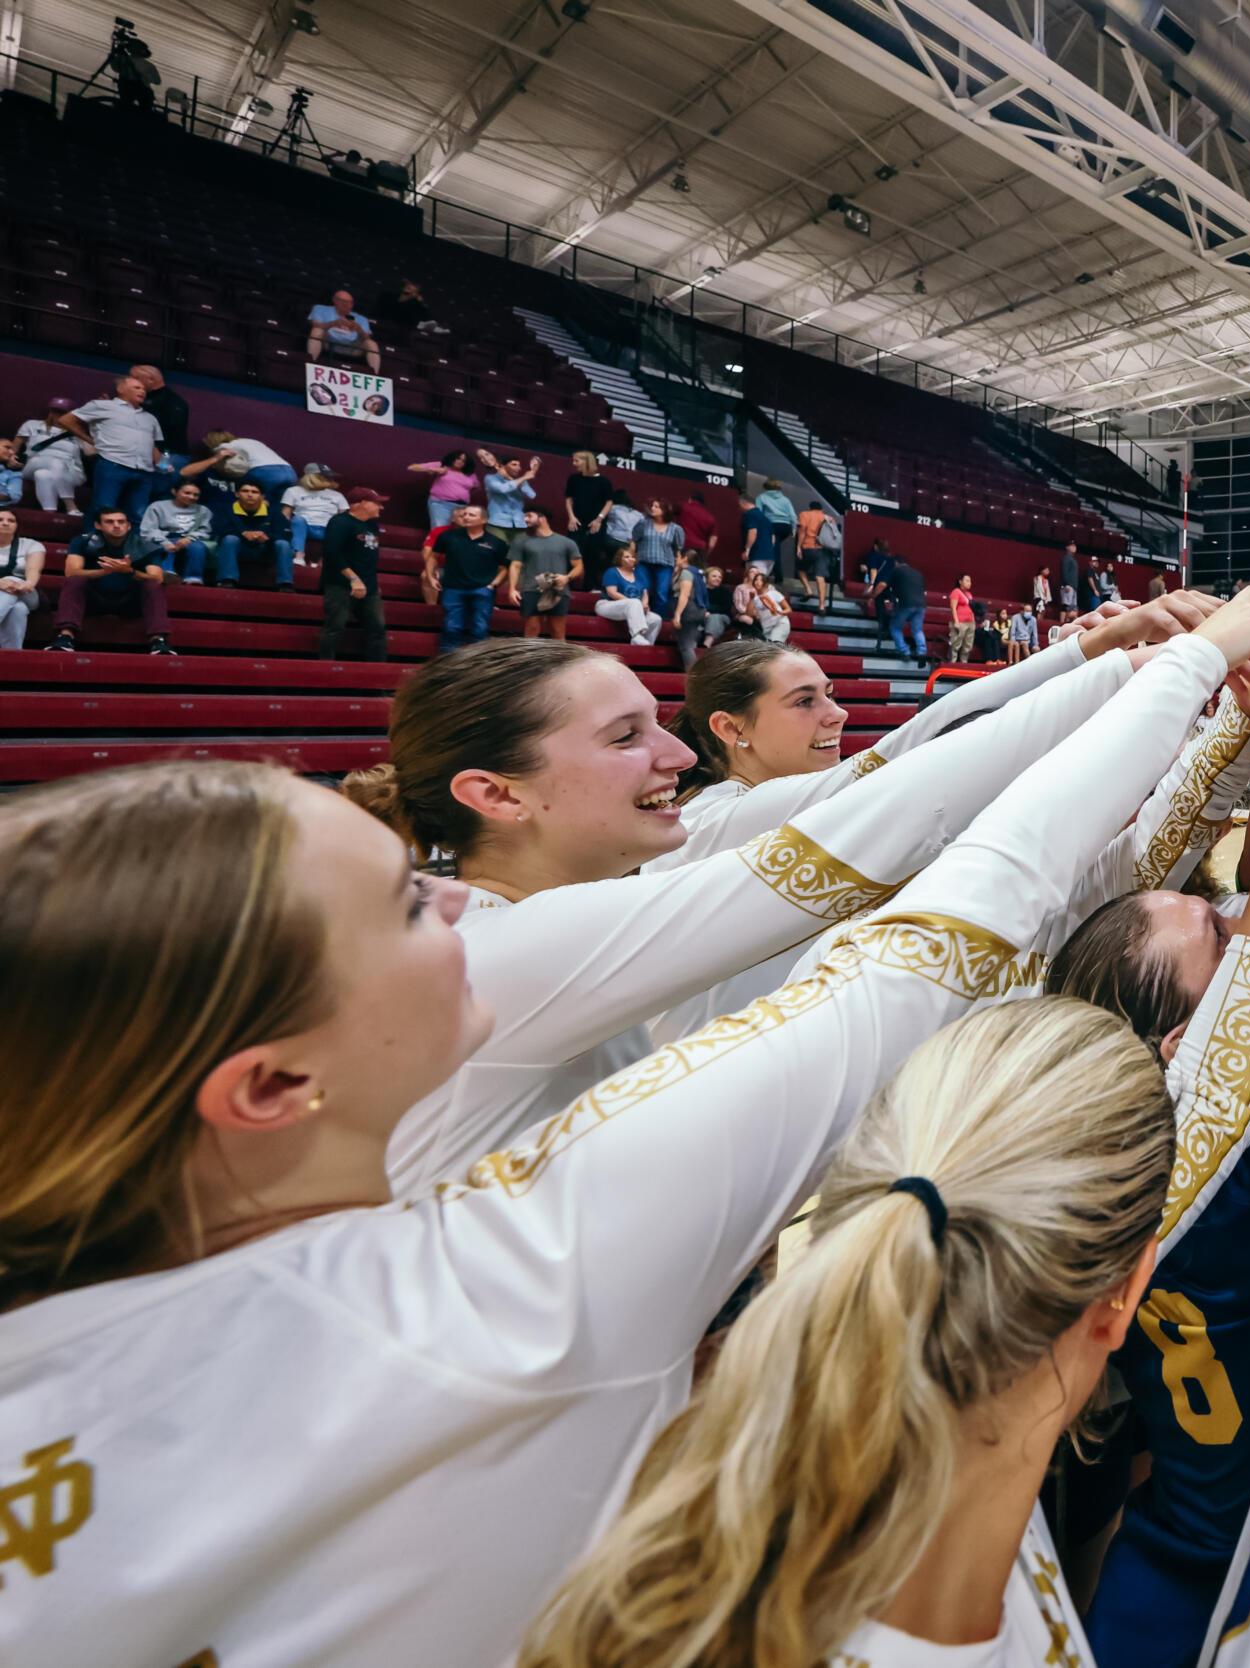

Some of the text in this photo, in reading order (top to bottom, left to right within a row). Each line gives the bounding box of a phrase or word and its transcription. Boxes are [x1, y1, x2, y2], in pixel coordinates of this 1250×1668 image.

[313, 366, 386, 393] RADEFF
[338, 393, 359, 408] 21
[617, 457, 637, 471] 211
[706, 474, 729, 487] 109
[850, 502, 869, 513] 110
[917, 515, 931, 526] 212
[1137, 1288, 1244, 1445] 8
